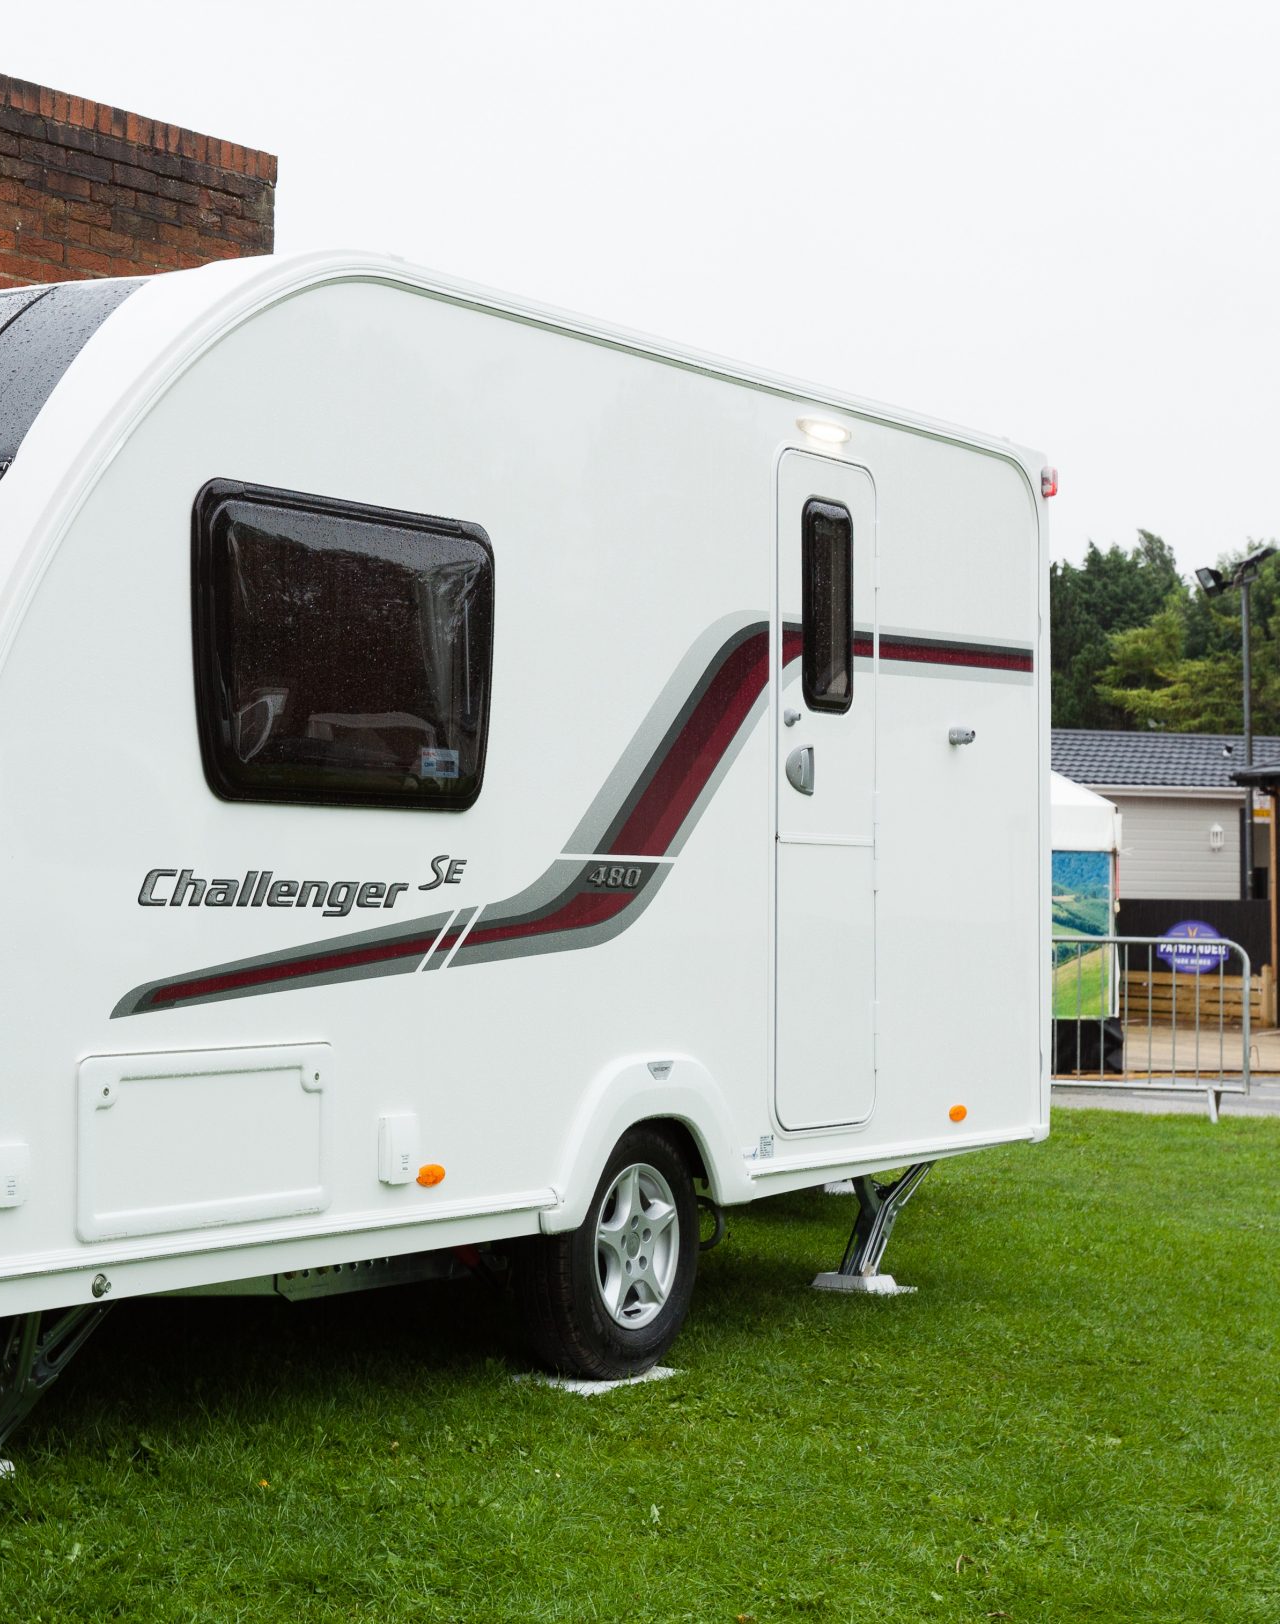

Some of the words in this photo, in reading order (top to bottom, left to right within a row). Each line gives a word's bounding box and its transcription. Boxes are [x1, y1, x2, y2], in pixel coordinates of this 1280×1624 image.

[137, 868, 410, 918] Challenger
[418, 854, 468, 891] SE
[587, 865, 642, 889] 480
